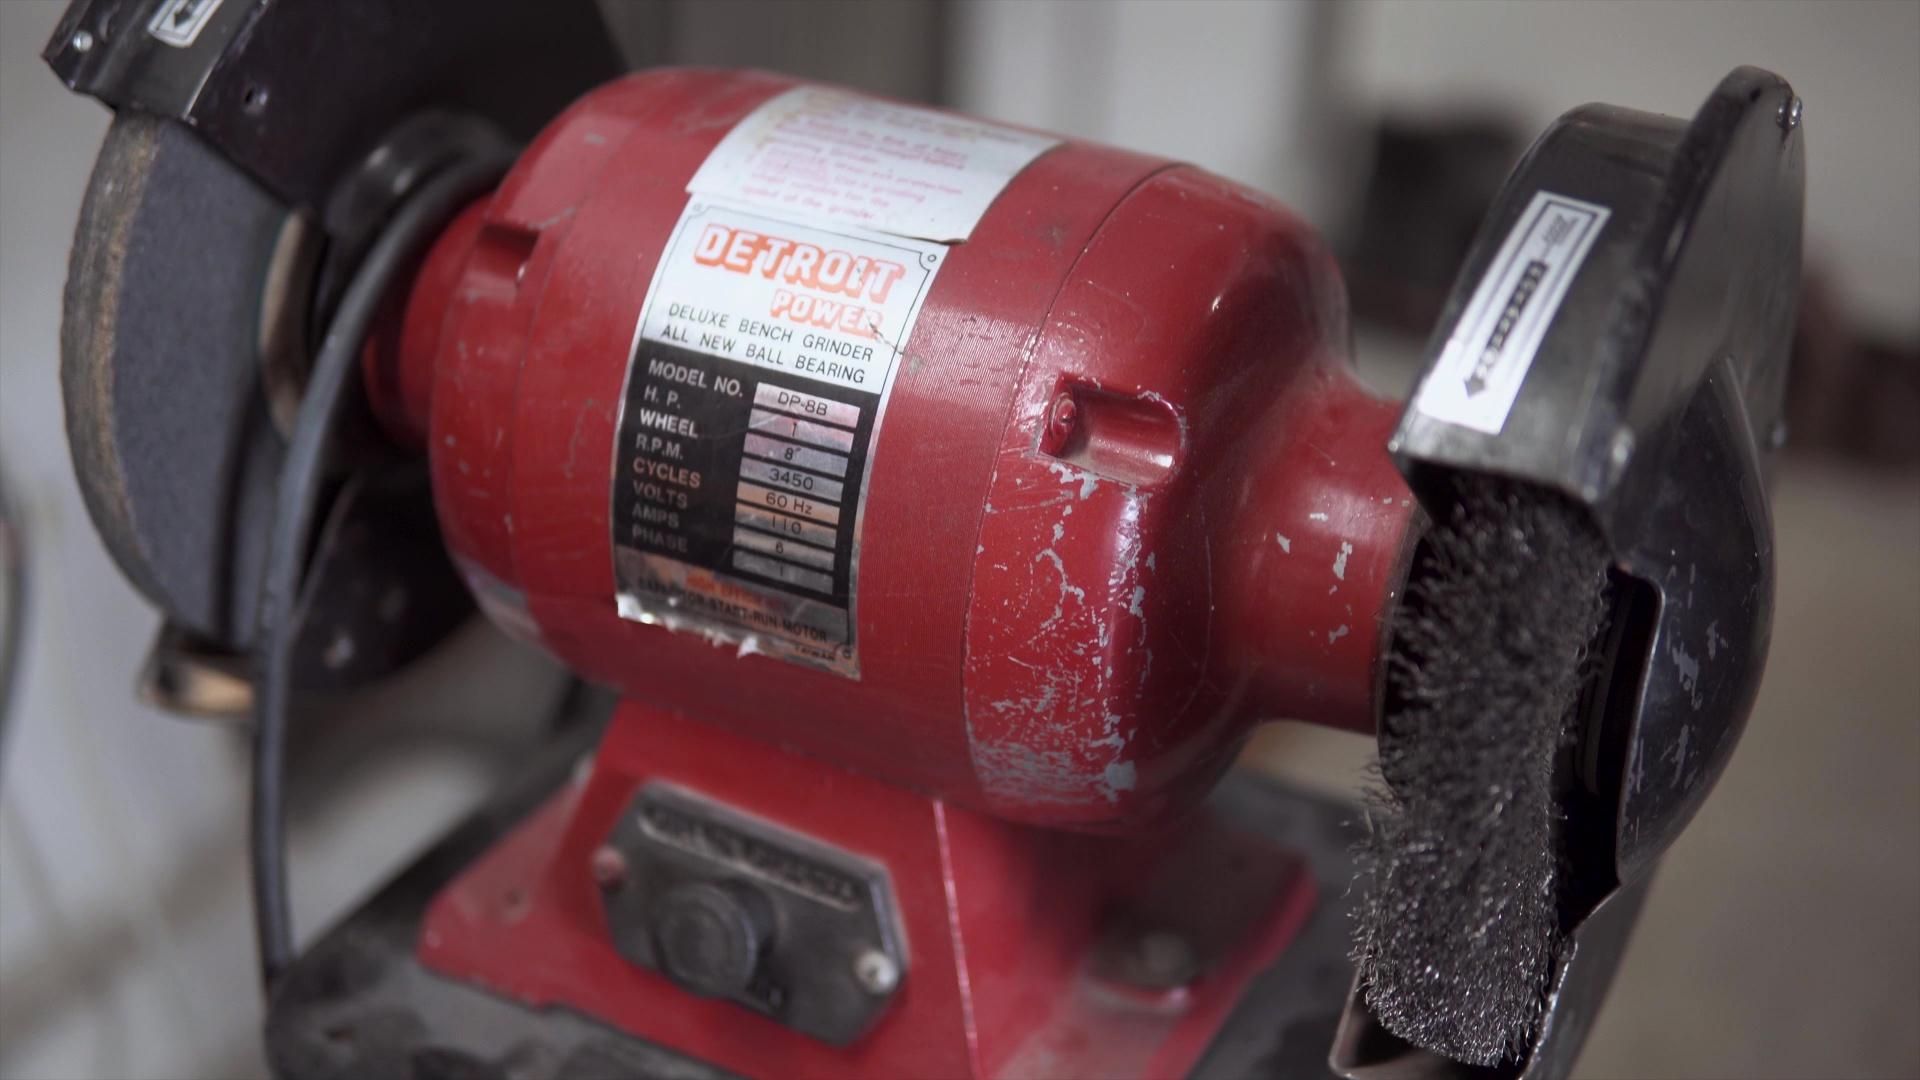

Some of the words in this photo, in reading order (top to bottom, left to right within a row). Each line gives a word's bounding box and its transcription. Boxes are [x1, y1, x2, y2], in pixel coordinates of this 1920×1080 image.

[694, 223, 906, 304] DETROIT
[668, 303, 729, 329] DELUXE
[738, 319, 792, 344] BENCH
[803, 335, 874, 363] GRINDER
[770, 288, 884, 340] POWER
[661, 324, 689, 344] ALL
[700, 333, 737, 355] NEW
[746, 343, 784, 366] BALL
[795, 354, 866, 384] BEARING
[648, 359, 707, 388] MODEL
[713, 376, 743, 398] NO.
[777, 391, 828, 417] DP-8B
[639, 408, 698, 439] WHEEL
[790, 421, 798, 438] 1
[632, 457, 700, 488] CYCLES
[765, 491, 788, 509] 60
[793, 499, 813, 516] Hz
[635, 433, 684, 460] R.P.M.
[768, 468, 814, 491] 3450
[631, 501, 680, 529] AMPS
[632, 480, 688, 509] VOLTS
[771, 515, 802, 535] 110
[631, 523, 689, 553] PHASE
